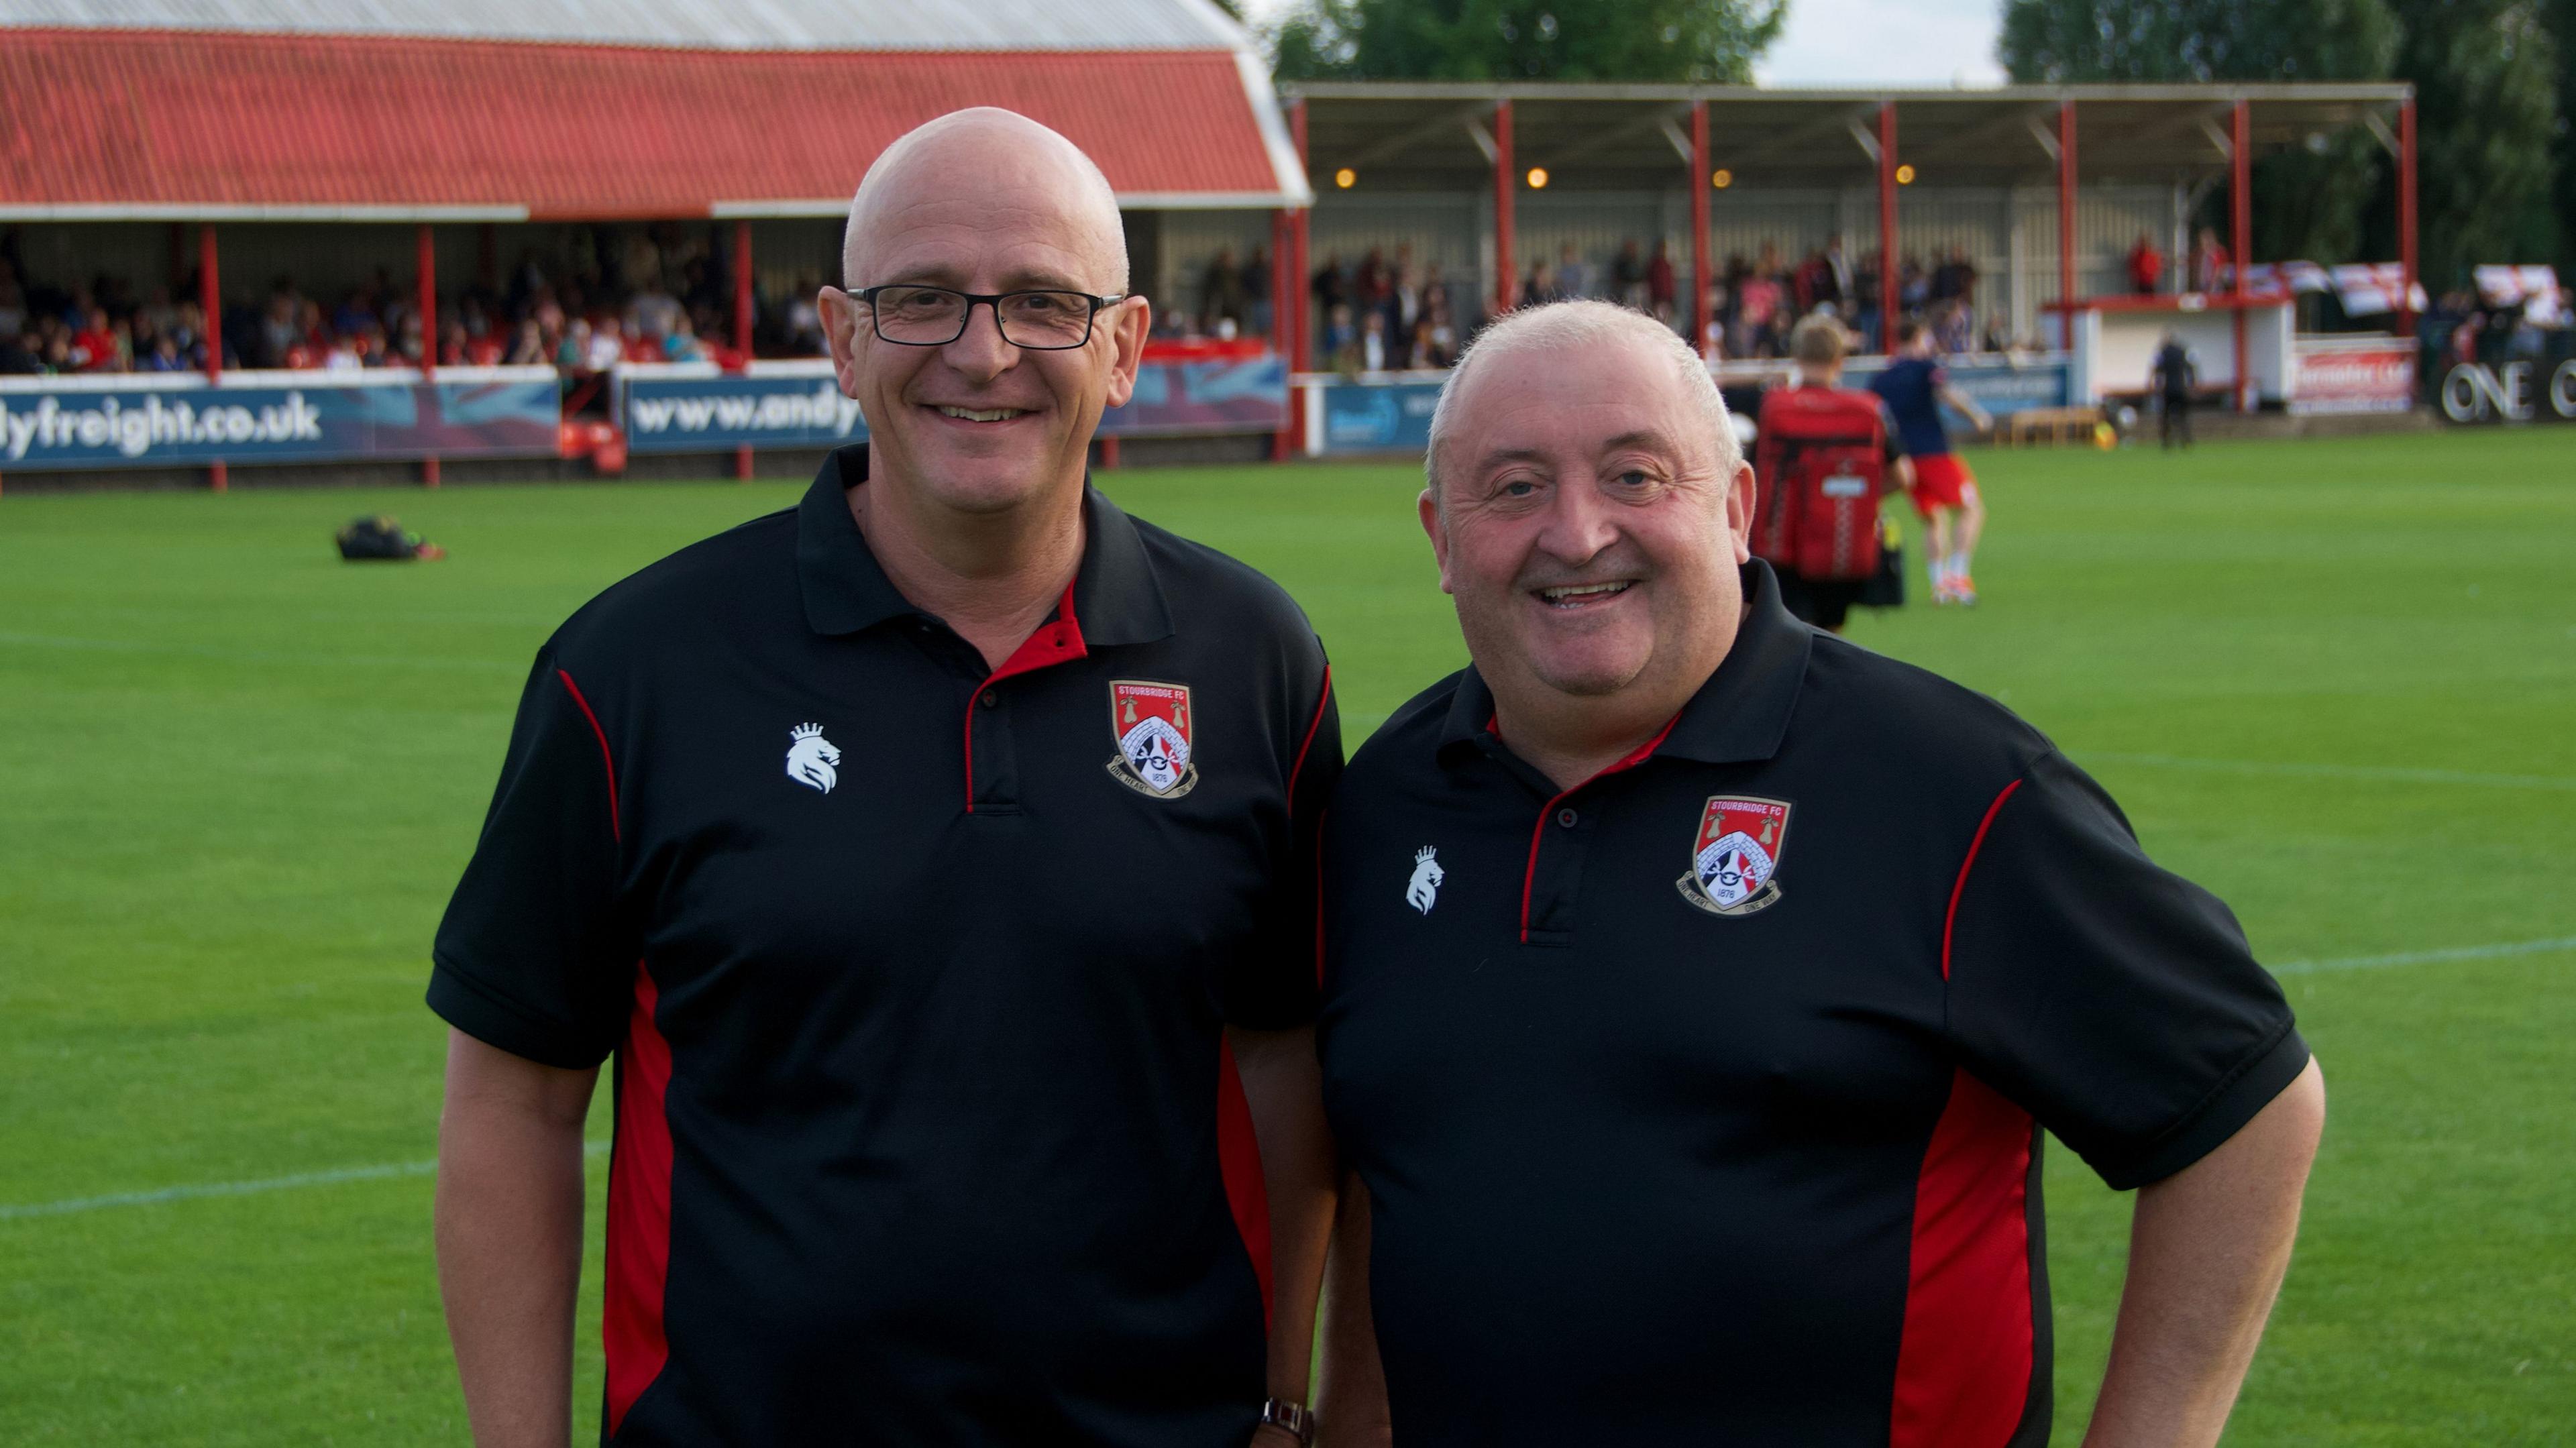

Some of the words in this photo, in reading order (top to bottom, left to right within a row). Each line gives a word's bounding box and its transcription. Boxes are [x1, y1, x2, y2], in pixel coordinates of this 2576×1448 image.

[634, 381, 866, 438] www.andy
[2442, 362, 2534, 421] ONE
[0, 392, 321, 460] yfreight.co.uk
[1119, 686, 1173, 698] STOURBRIDGE
[1175, 691, 1185, 700] FC
[1711, 801, 1768, 814] STOURBRIDGE
[1770, 806, 1782, 816] FC
